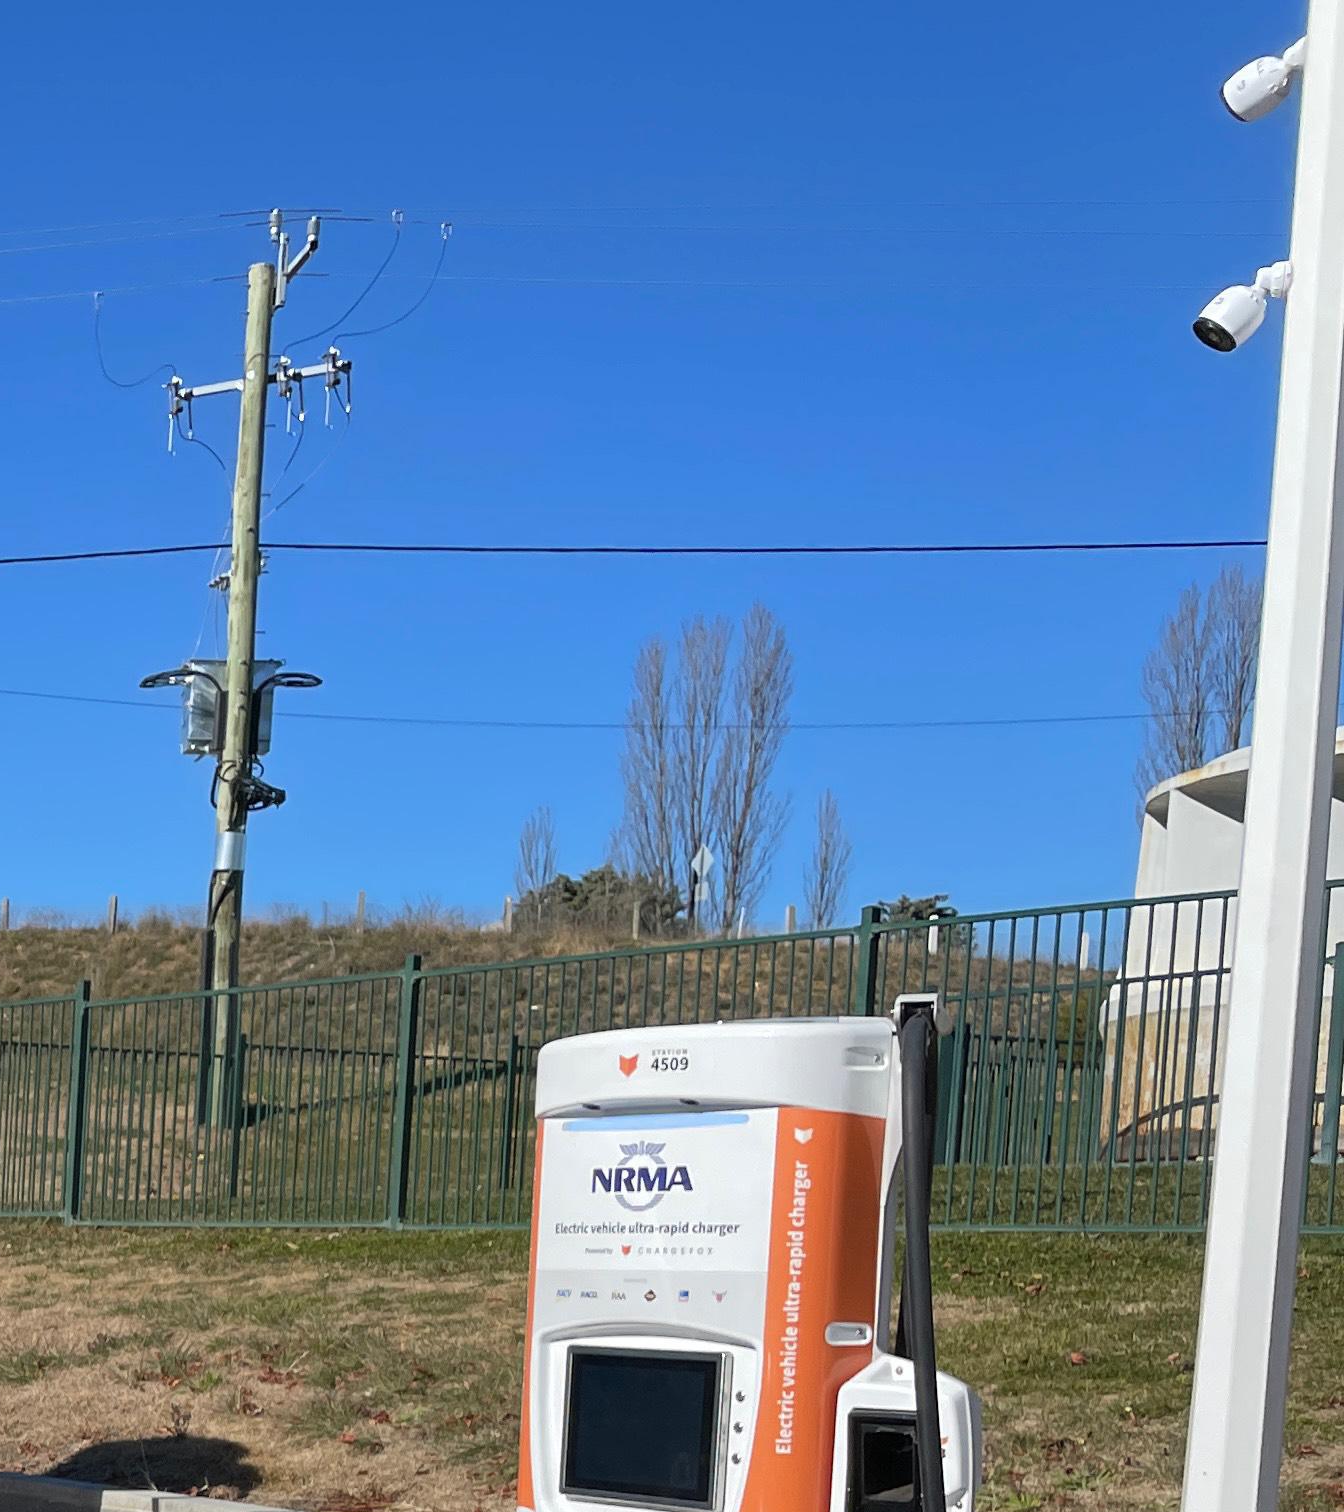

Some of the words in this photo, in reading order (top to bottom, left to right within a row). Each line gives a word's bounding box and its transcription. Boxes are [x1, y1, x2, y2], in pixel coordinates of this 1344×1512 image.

[651, 1057, 689, 1071] 4509
[591, 1166, 693, 1193] NRMA
[788, 1160, 811, 1227] charger
[555, 1223, 589, 1234] Electric
[591, 1222, 626, 1235] vehicle
[628, 1222, 689, 1236] ultra-rapid
[692, 1221, 740, 1236] charger
[783, 1230, 807, 1325] ultra-rapid
[778, 1332, 799, 1388] vehicle
[775, 1391, 795, 1455] Electric
